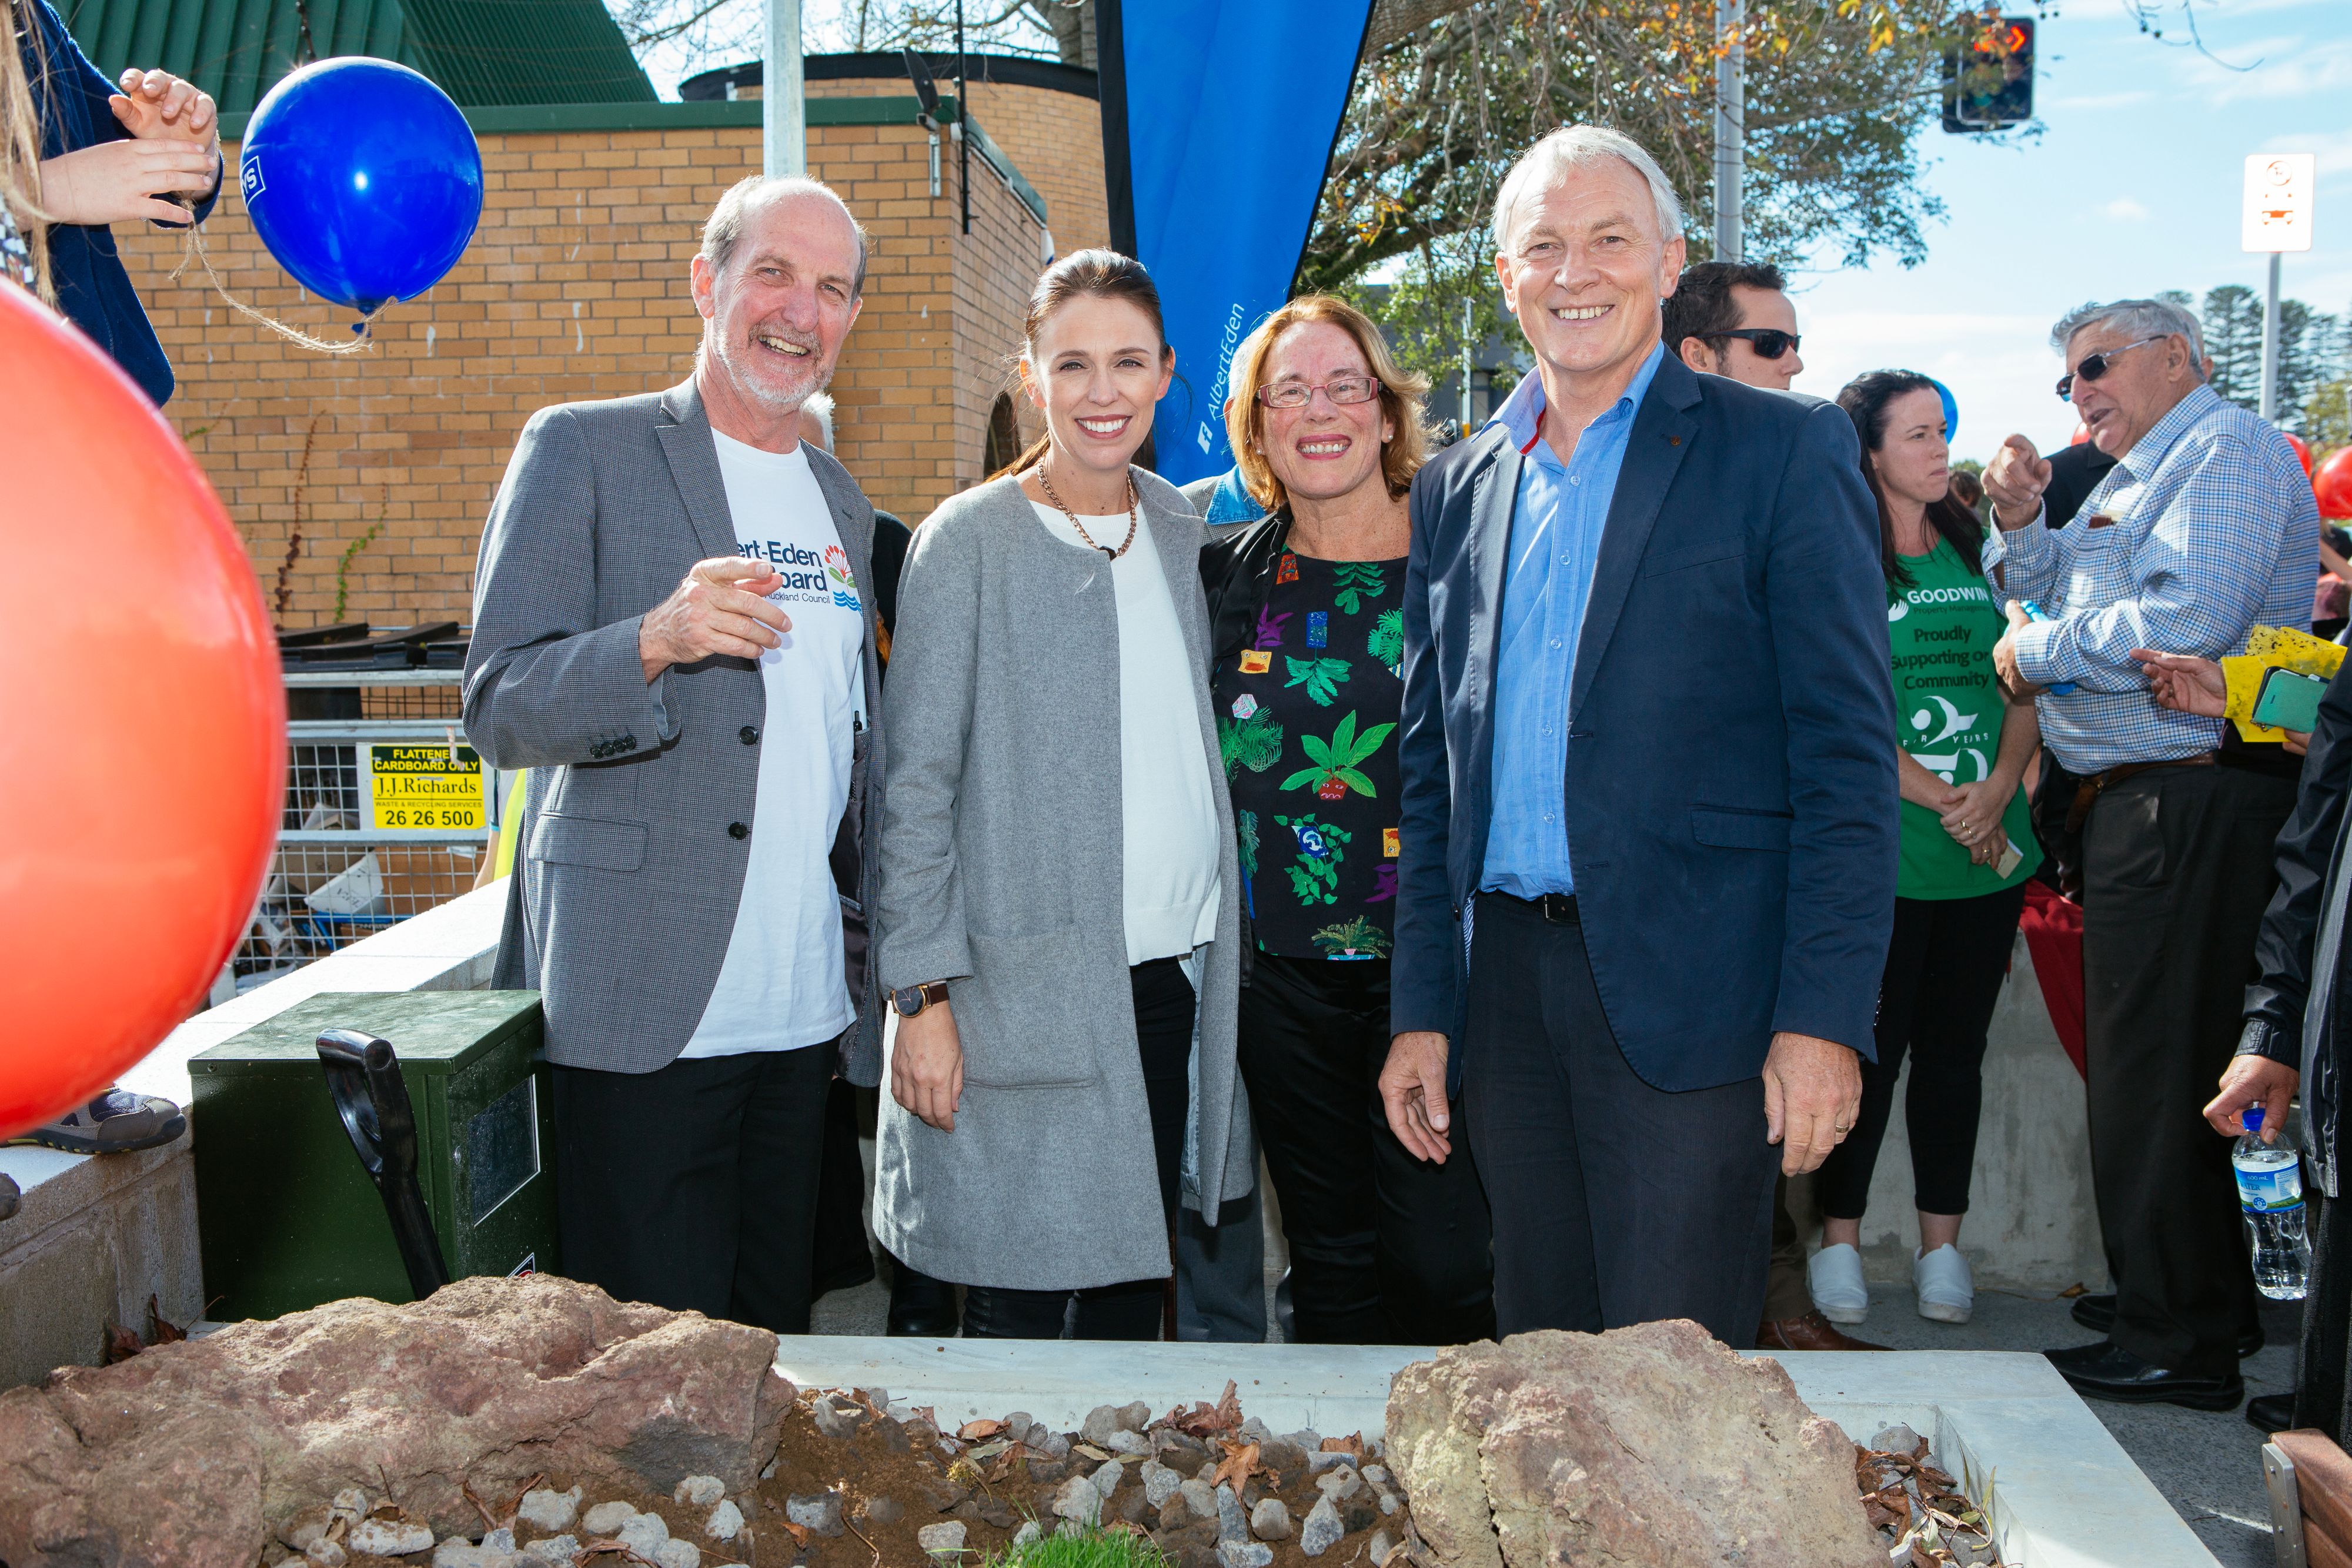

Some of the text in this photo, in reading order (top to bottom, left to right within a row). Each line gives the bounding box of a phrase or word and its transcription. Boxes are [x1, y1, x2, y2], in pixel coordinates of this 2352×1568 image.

[1208, 303, 1245, 421] AlbertEden
[771, 566, 828, 591] oard
[802, 593, 830, 604] Council
[1907, 587, 1989, 604] GOODWIN
[1913, 606, 1947, 615] Property
[1913, 625, 1972, 643] Proudly
[1904, 671, 1989, 690] Community
[393, 749, 454, 759] FLATTENE
[374, 761, 446, 770] CARDBOARD
[377, 777, 477, 797] J.J.Richards
[385, 810, 473, 825] 26 26 500
